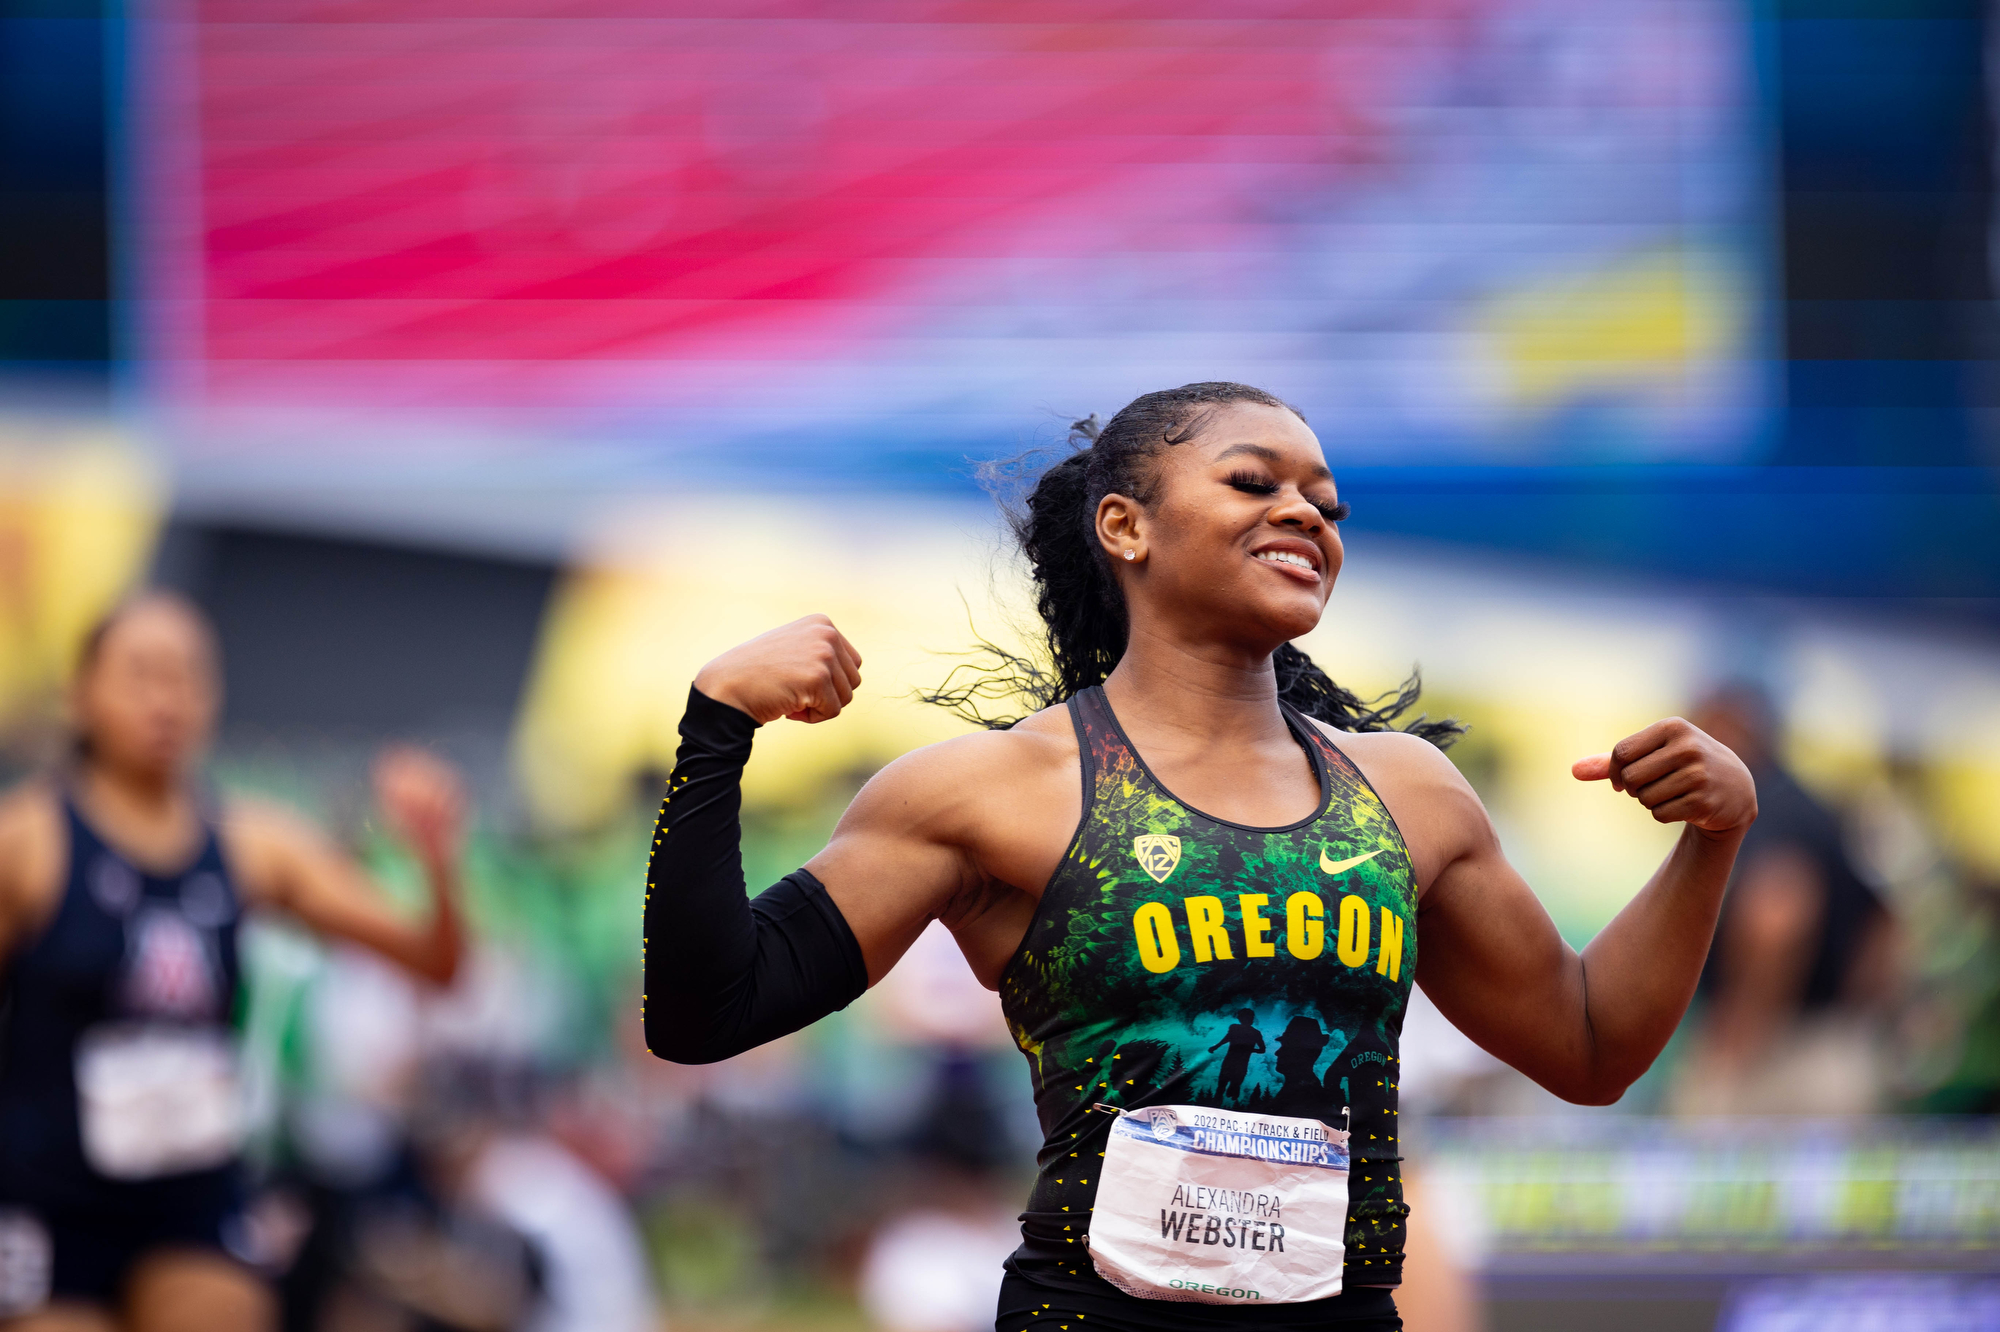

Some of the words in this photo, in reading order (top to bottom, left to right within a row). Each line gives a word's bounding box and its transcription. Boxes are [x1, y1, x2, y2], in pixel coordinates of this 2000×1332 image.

[1137, 837, 1178, 862] PAC
[1148, 853, 1171, 872] 12
[1133, 891, 1403, 983] OREGON
[1351, 1051, 1387, 1069] OREGON
[1194, 1114, 1217, 1128] 2022
[1258, 1123, 1290, 1137] TRACK
[1293, 1126, 1300, 1139] &
[1304, 1127, 1329, 1142] FIELD
[1193, 1130, 1329, 1165] CHAMPIONSHIPS
[1170, 1185, 1281, 1218] ALEXANDRA
[1161, 1209, 1285, 1252] WEBSTER
[1169, 1279, 1260, 1300] OREGON
